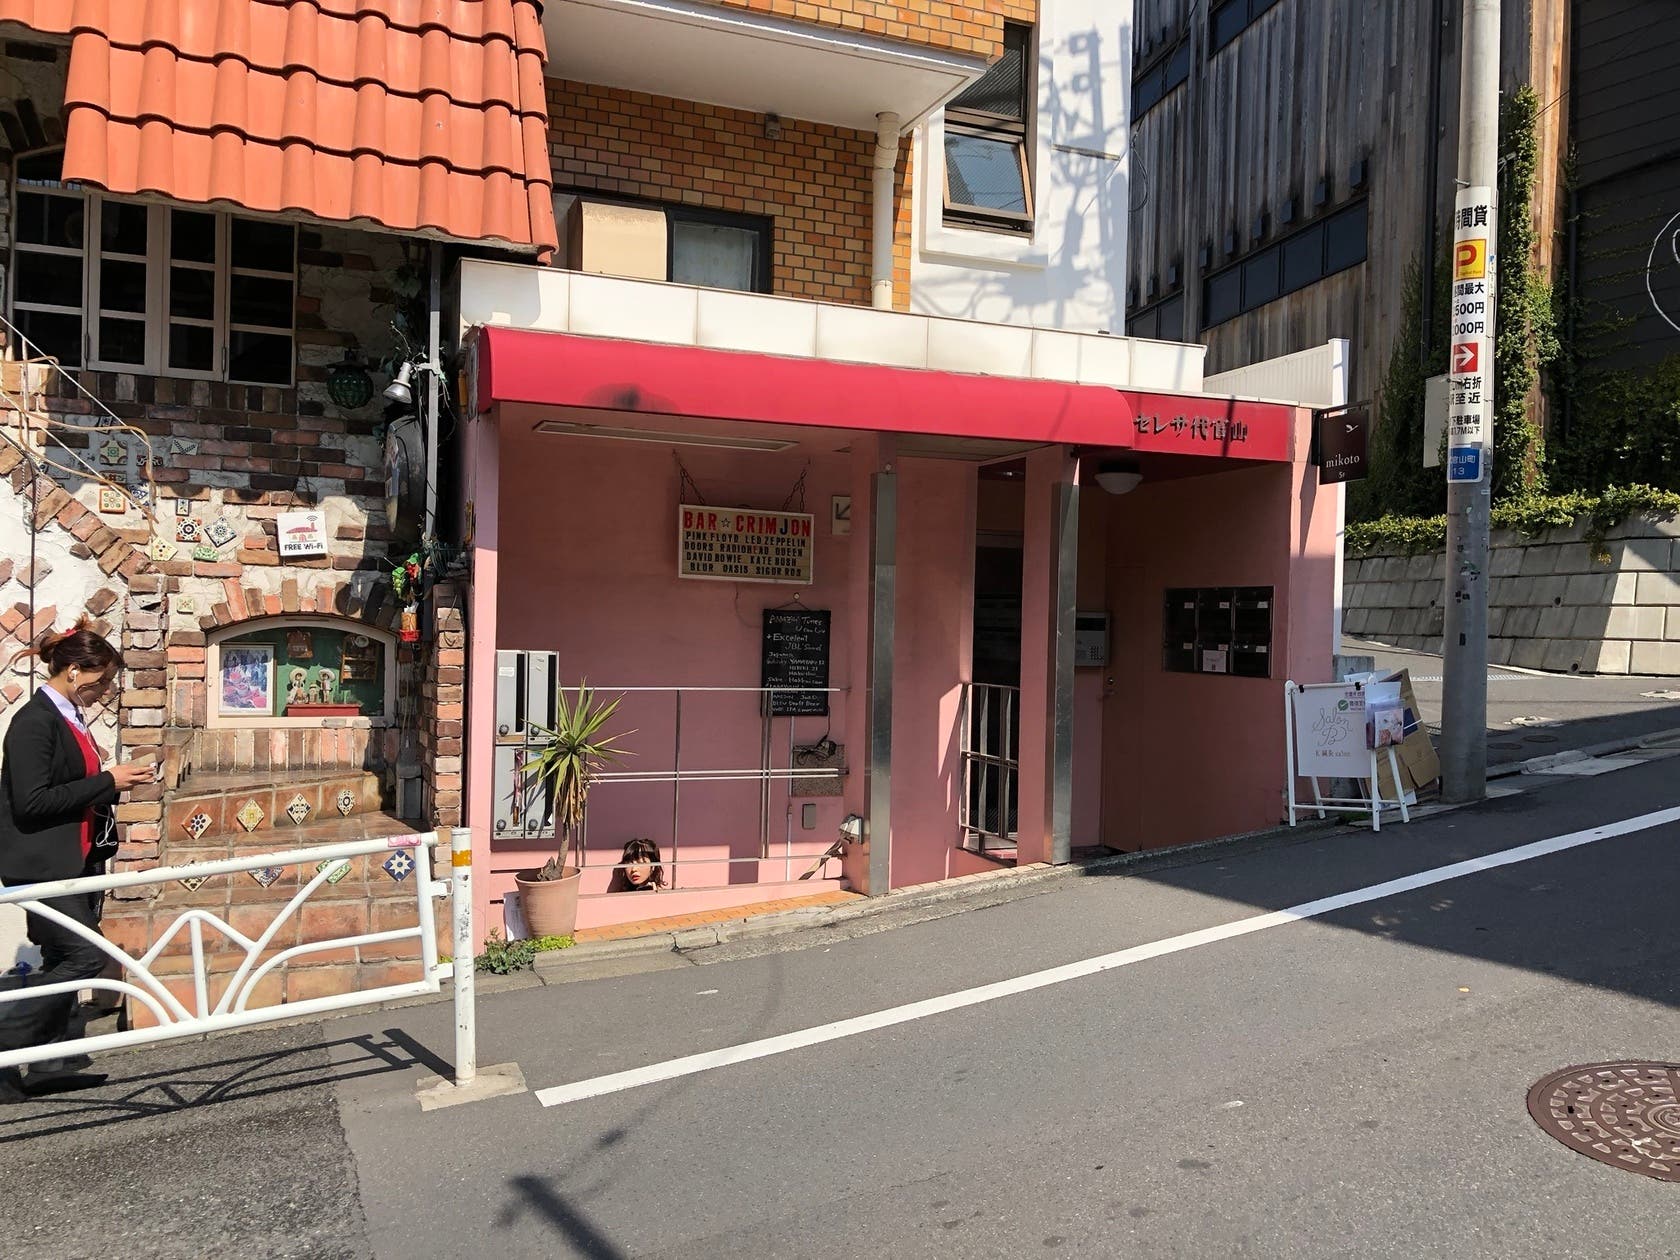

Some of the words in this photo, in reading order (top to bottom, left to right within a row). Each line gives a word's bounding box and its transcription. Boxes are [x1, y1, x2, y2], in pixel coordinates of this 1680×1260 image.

[1326, 453, 1360, 468] mikoto
[684, 511, 717, 531] BAR
[686, 531, 706, 541] PINK
[710, 533, 739, 543] FLOYD
[745, 535, 762, 545] LED
[764, 536, 806, 547] ZEPPELIN
[685, 541, 714, 551] DOORS
[720, 543, 769, 555] RADIOHEAD
[775, 547, 803, 557] QUEEN
[686, 552, 713, 562] DAVID
[714, 553, 742, 564] BOWIE
[750, 555, 772, 565] KATE
[774, 556, 797, 567] BUSH
[690, 563, 714, 572] BLUR
[722, 564, 749, 574] OASIS
[784, 568, 801, 577] ROS
